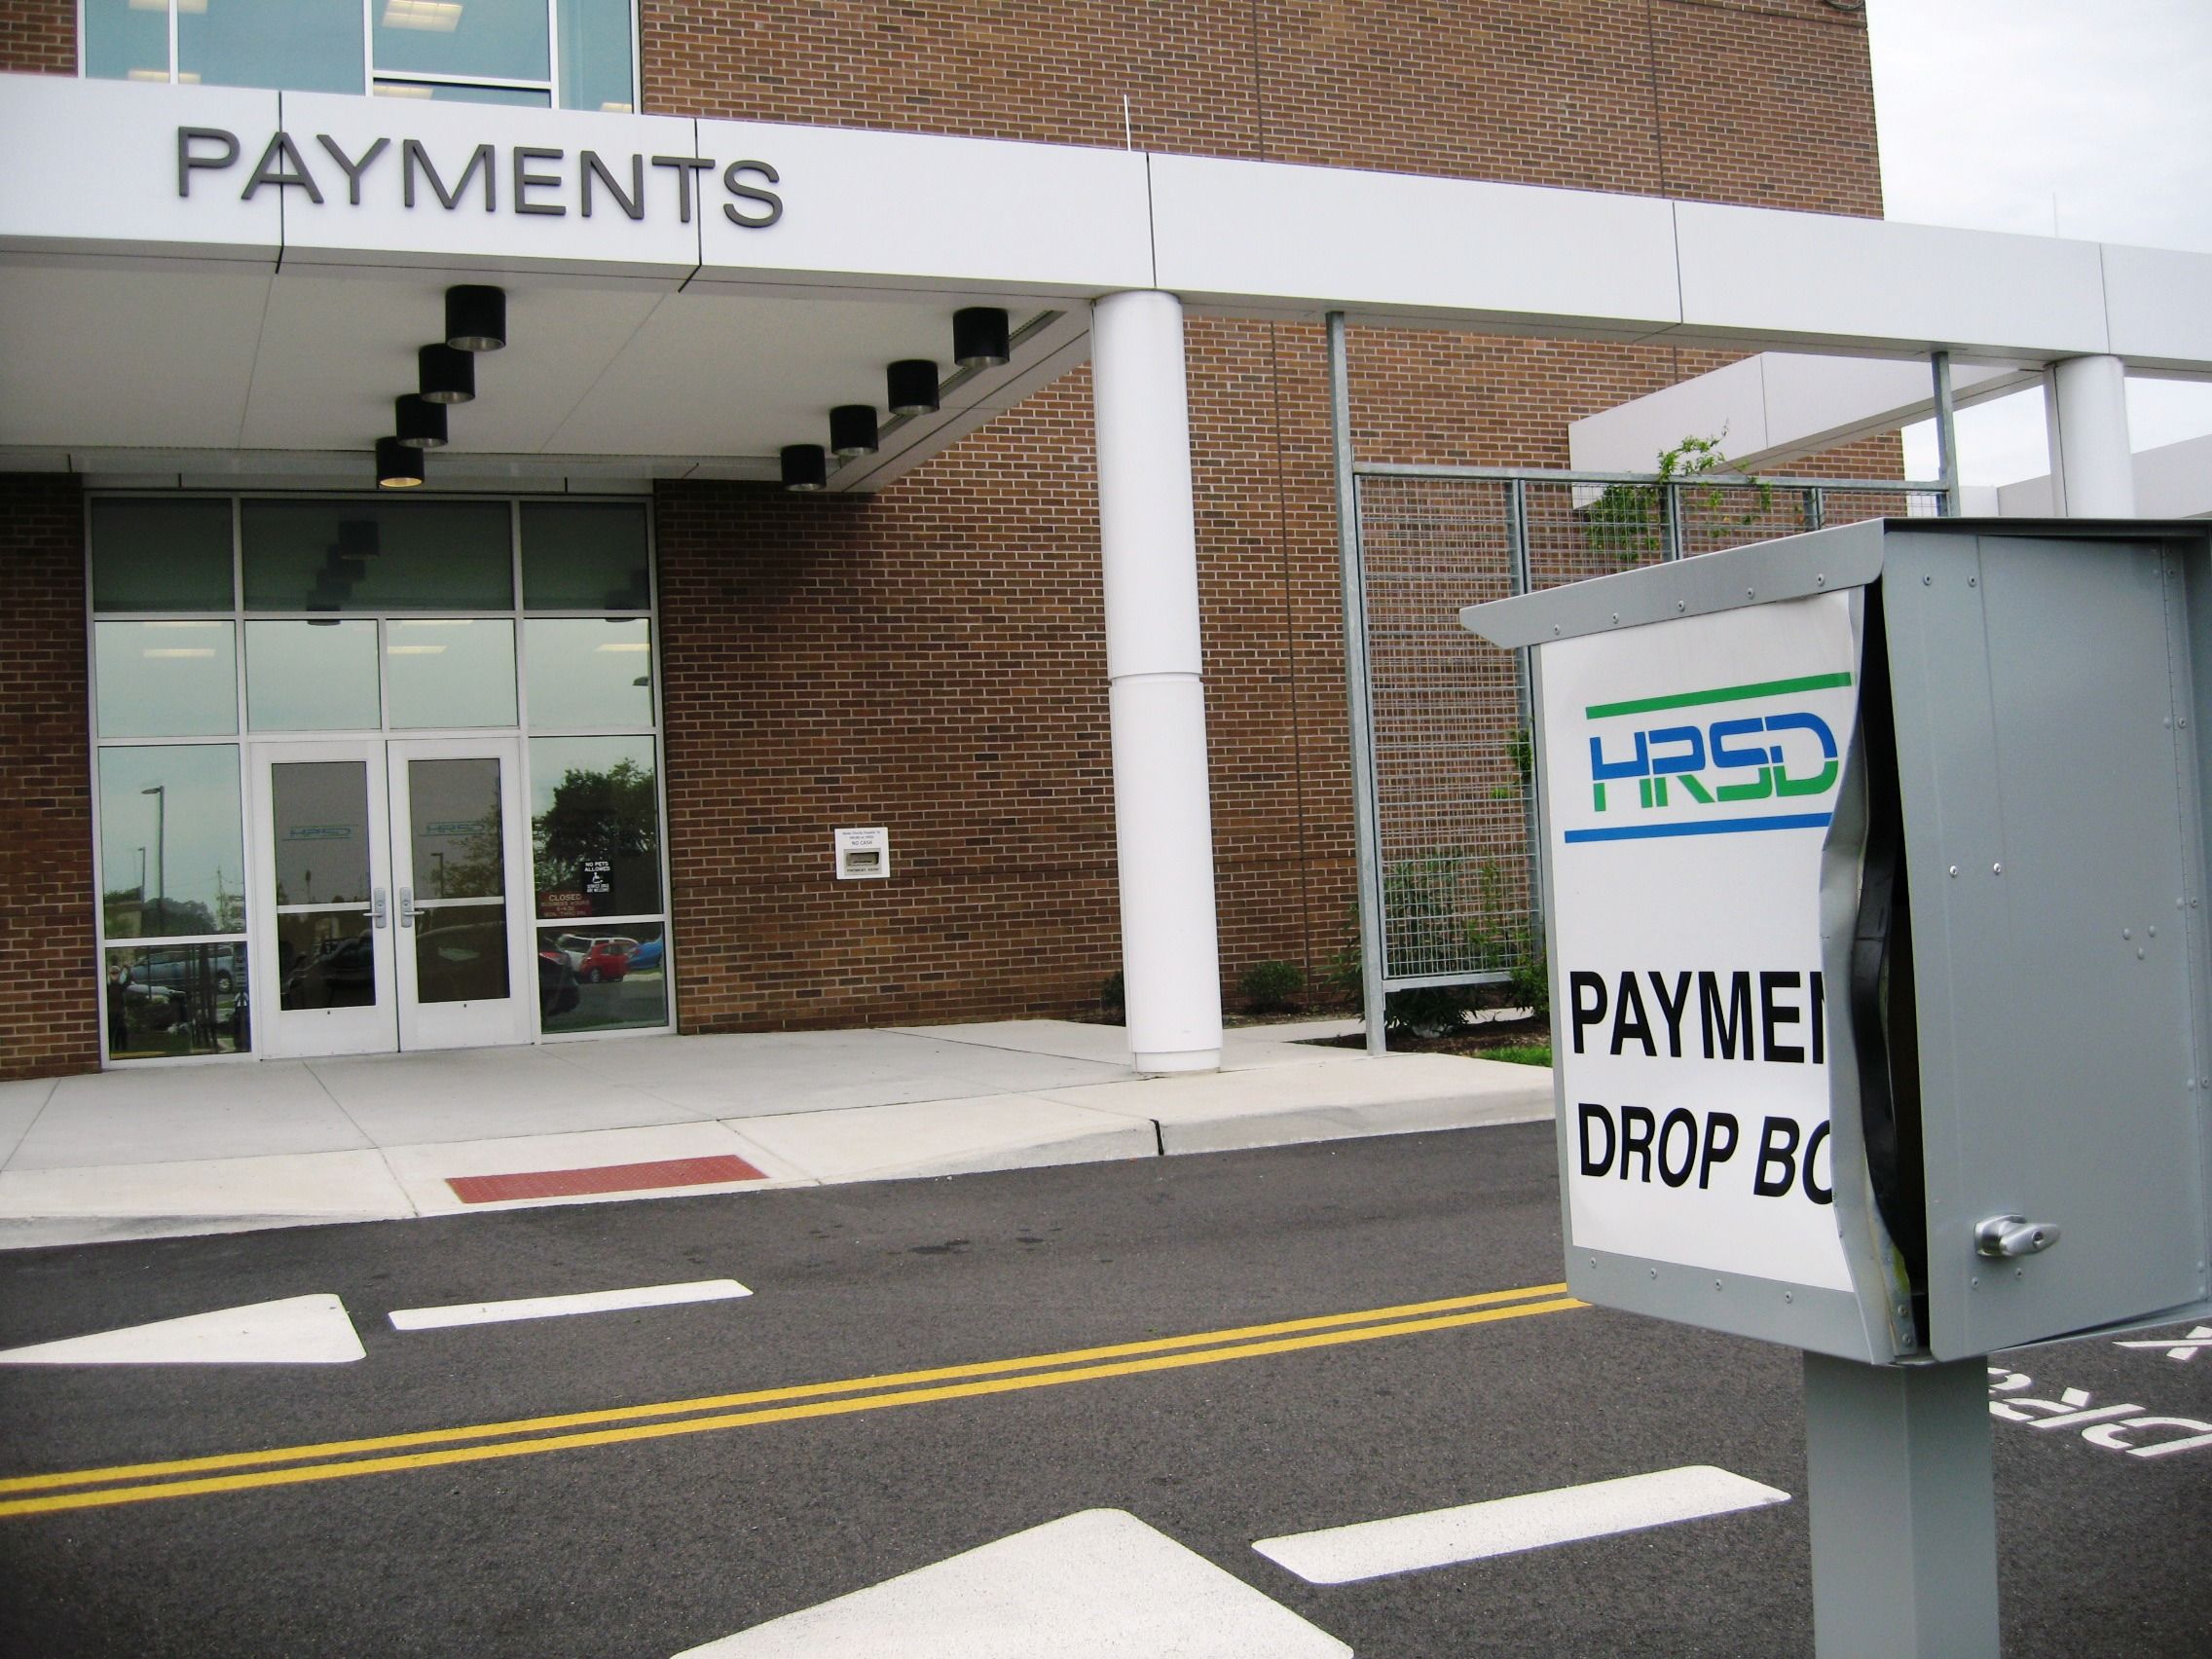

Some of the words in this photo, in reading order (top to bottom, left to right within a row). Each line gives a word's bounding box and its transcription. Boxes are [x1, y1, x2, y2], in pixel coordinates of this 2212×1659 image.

[177, 126, 783, 228] PAYMENTS
[1589, 712, 1839, 812] HRSD
[1577, 1103, 1738, 1191] DROP
